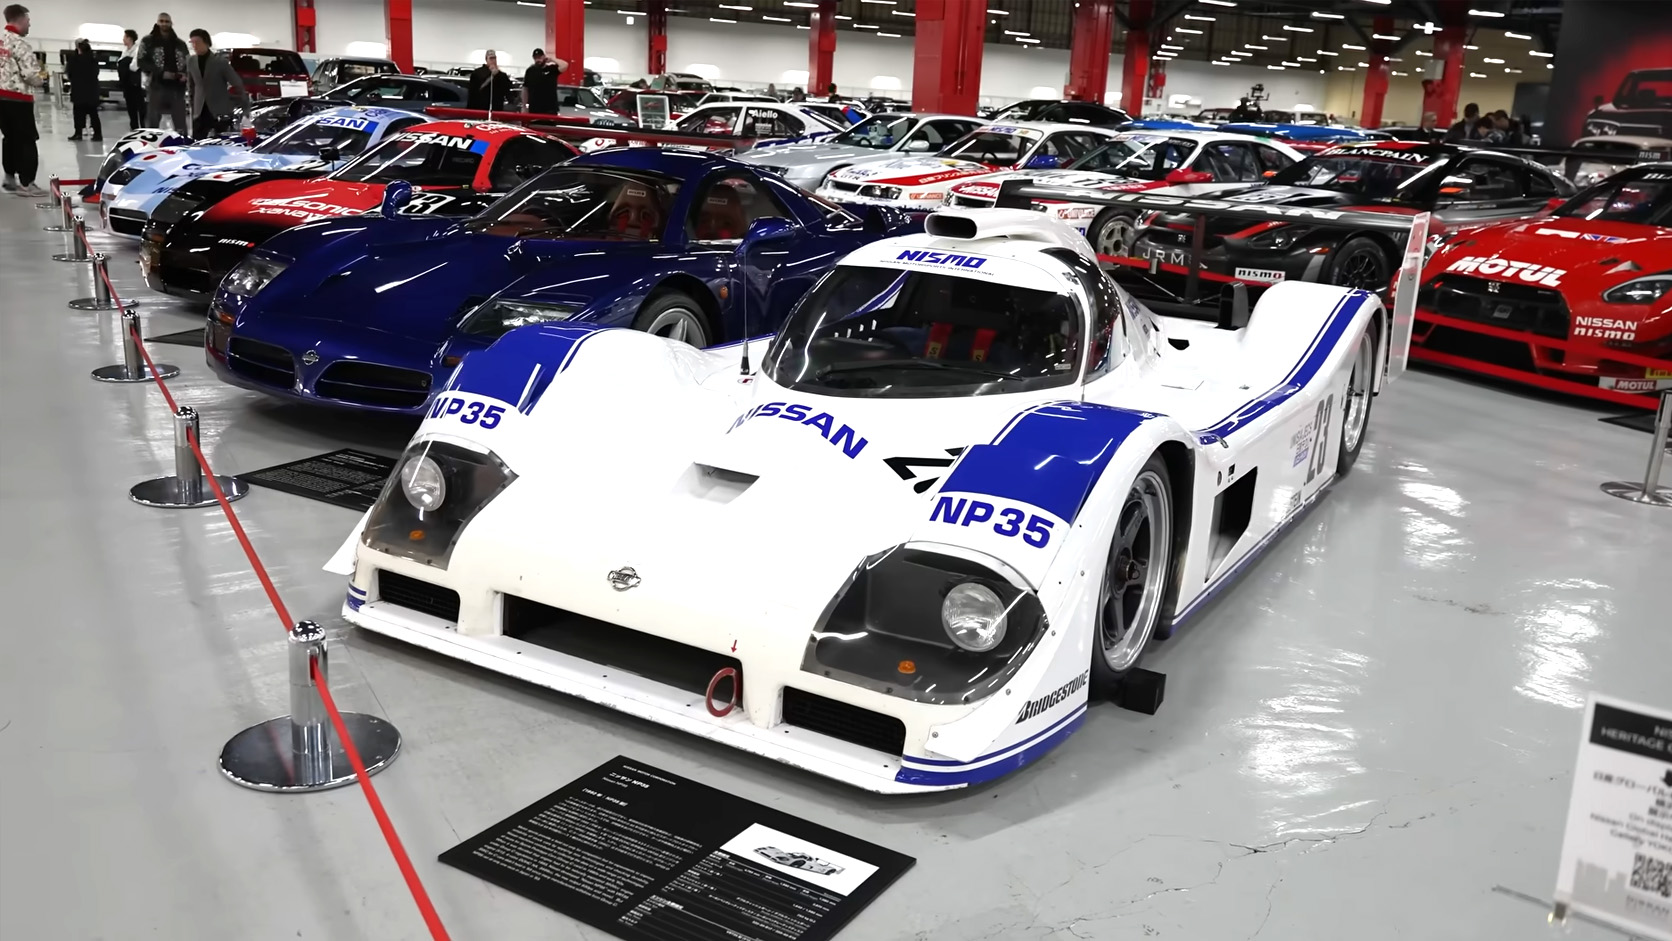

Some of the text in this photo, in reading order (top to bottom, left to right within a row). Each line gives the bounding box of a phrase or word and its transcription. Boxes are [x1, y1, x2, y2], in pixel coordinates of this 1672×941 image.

[752, 109, 778, 118] Aiello
[896, 250, 987, 269] NISMO
[1141, 249, 1185, 266] JRM
[1238, 269, 1284, 280] nismo
[1446, 256, 1567, 287] MOTUL
[1575, 316, 1638, 331] NISSAN
[1573, 327, 1636, 341] nismo
[1617, 381, 1655, 390] MOTUL
[425, 397, 507, 430] NP35
[929, 496, 1056, 549] NP35
[1016, 669, 1090, 725] BRIDGESTONE
[1601, 727, 1665, 751] HERITAGE
